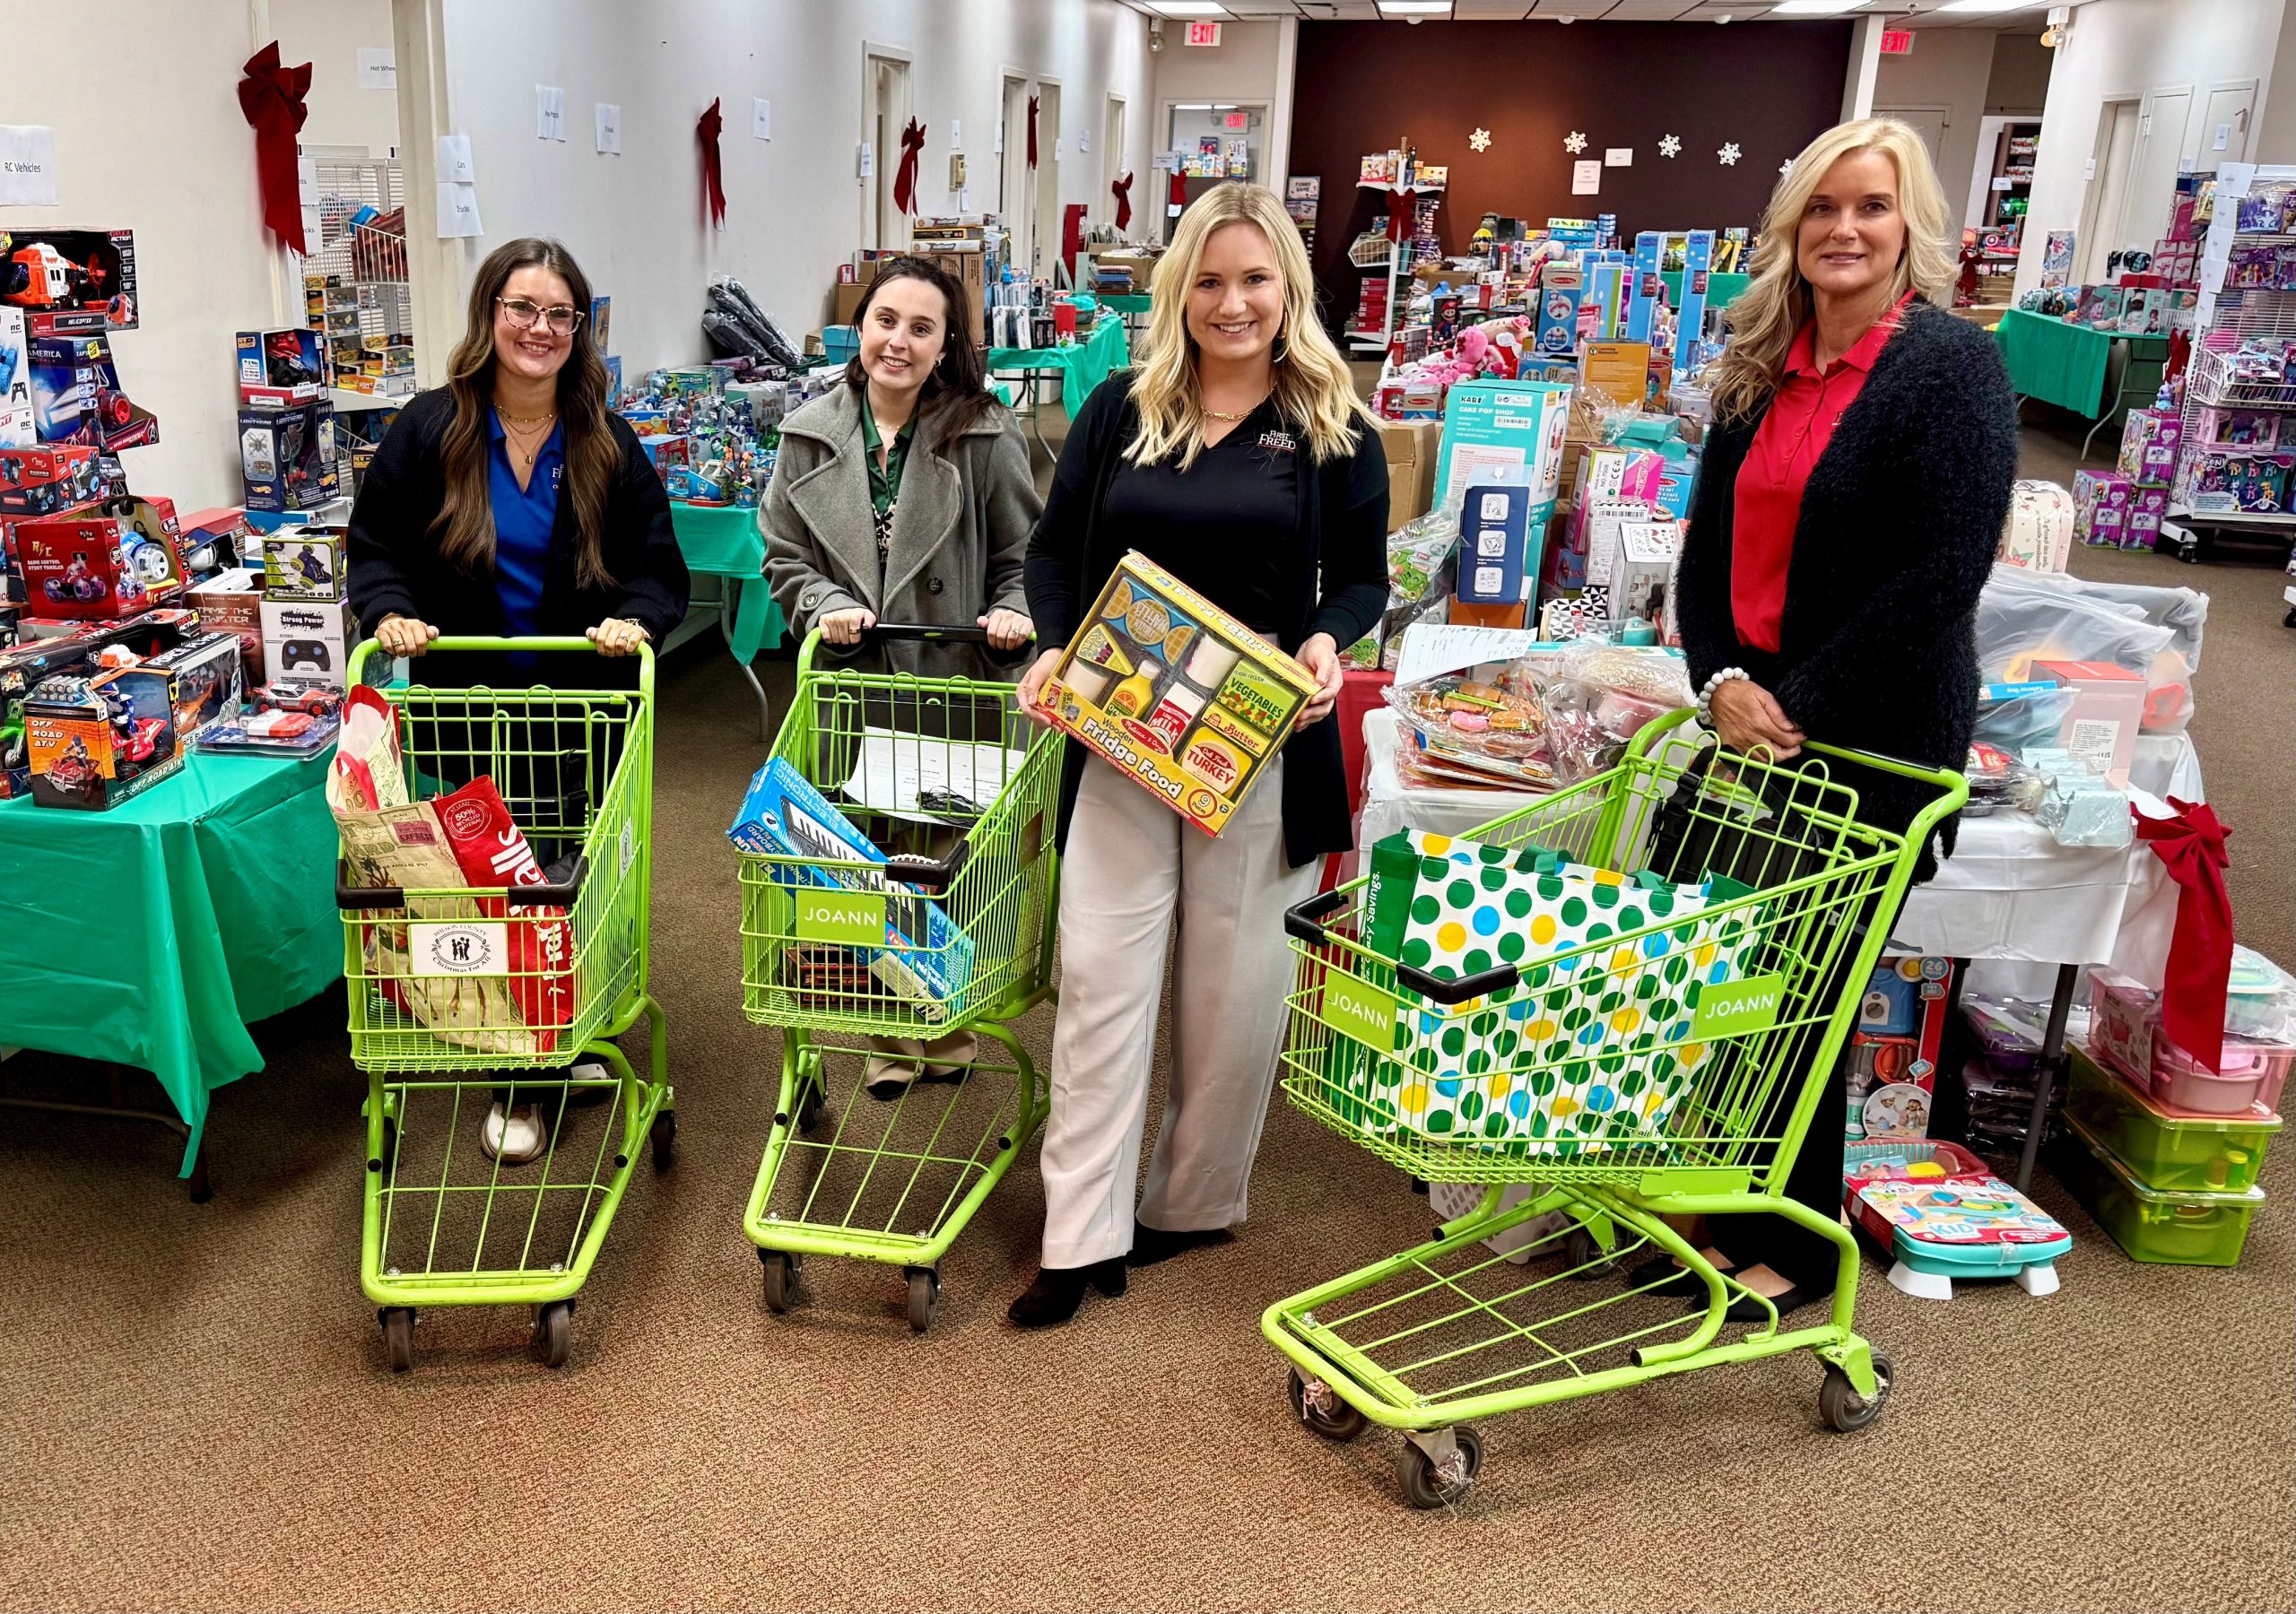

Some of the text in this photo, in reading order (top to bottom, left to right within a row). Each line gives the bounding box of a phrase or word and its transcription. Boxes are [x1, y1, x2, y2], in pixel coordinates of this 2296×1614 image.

[1191, 23, 1217, 44] EXIT
[1882, 31, 1912, 53] EXIT
[4, 162, 41, 173] RC Vehicles
[28, 351, 62, 359] AMERICA
[1269, 430, 1291, 439] FIRST
[196, 606, 253, 615] TAME THE
[282, 616, 303, 624] Strong
[1134, 602, 1169, 635] WAFFLES
[176, 615, 192, 627] MAX
[148, 632, 223, 666] FORCE FLYER
[1231, 677, 1284, 719] VEGETABLES
[32, 730, 64, 739] ROAD
[1102, 717, 1134, 746] Wooden
[1124, 720, 1147, 741] Melissa
[1152, 740, 1166, 754] Doug
[1150, 717, 1179, 743] MILK
[1224, 723, 1258, 750] Butter
[33, 740, 57, 748] ATV
[1082, 717, 1185, 800] Fridge Food
[1187, 749, 1235, 785] TURKEY
[131, 759, 184, 793] OFF ROAD ATV
[779, 759, 834, 814] KEYBOARD
[776, 768, 839, 829] ELECTRONIC
[1197, 794, 1211, 808] 9
[455, 808, 476, 821] 50%
[456, 813, 481, 828] RECYCLED
[458, 818, 483, 832] MATERIAL
[400, 833, 434, 842] EXPRESS
[1366, 871, 1381, 920] Savings.
[804, 907, 878, 927] JOANN
[433, 924, 489, 937] WILSON COUNTY
[432, 956, 467, 973] Christmas
[481, 957, 491, 967] All
[1926, 960, 1944, 970] 26
[1331, 991, 1387, 1031] JOANN
[1705, 993, 1775, 1020] JOANN
[1929, 1224, 1973, 1235] KID
